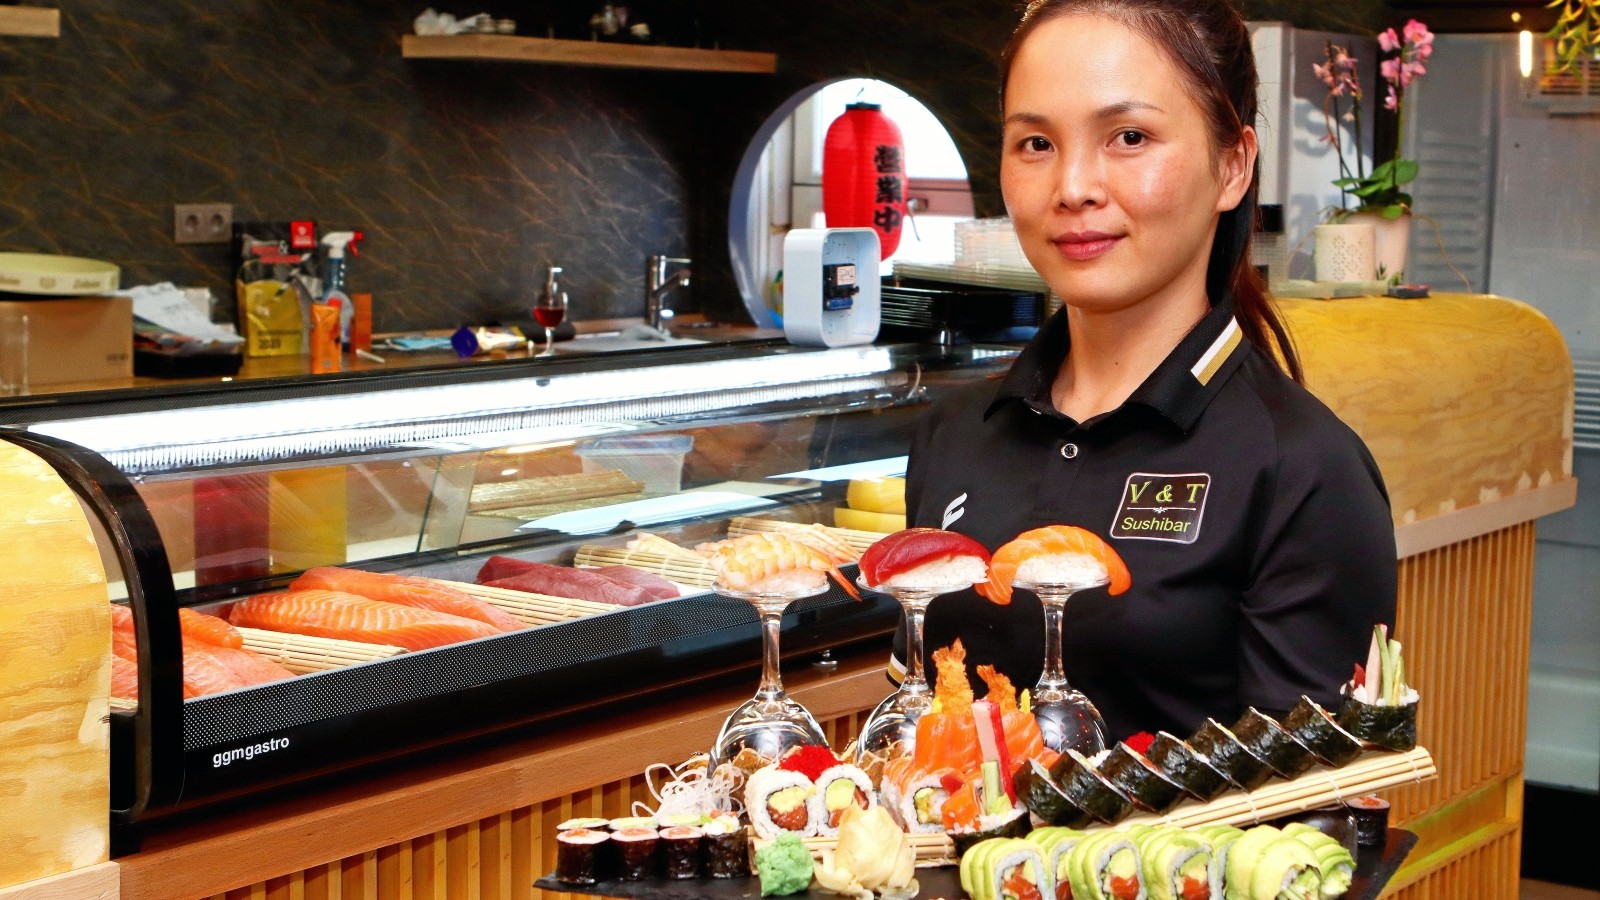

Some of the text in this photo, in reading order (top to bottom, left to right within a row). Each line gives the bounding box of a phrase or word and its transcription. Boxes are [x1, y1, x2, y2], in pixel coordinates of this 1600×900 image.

[1130, 481, 1206, 503] V & T
[1121, 517, 1192, 532] Sushibar
[212, 737, 290, 768] ggmgastro
